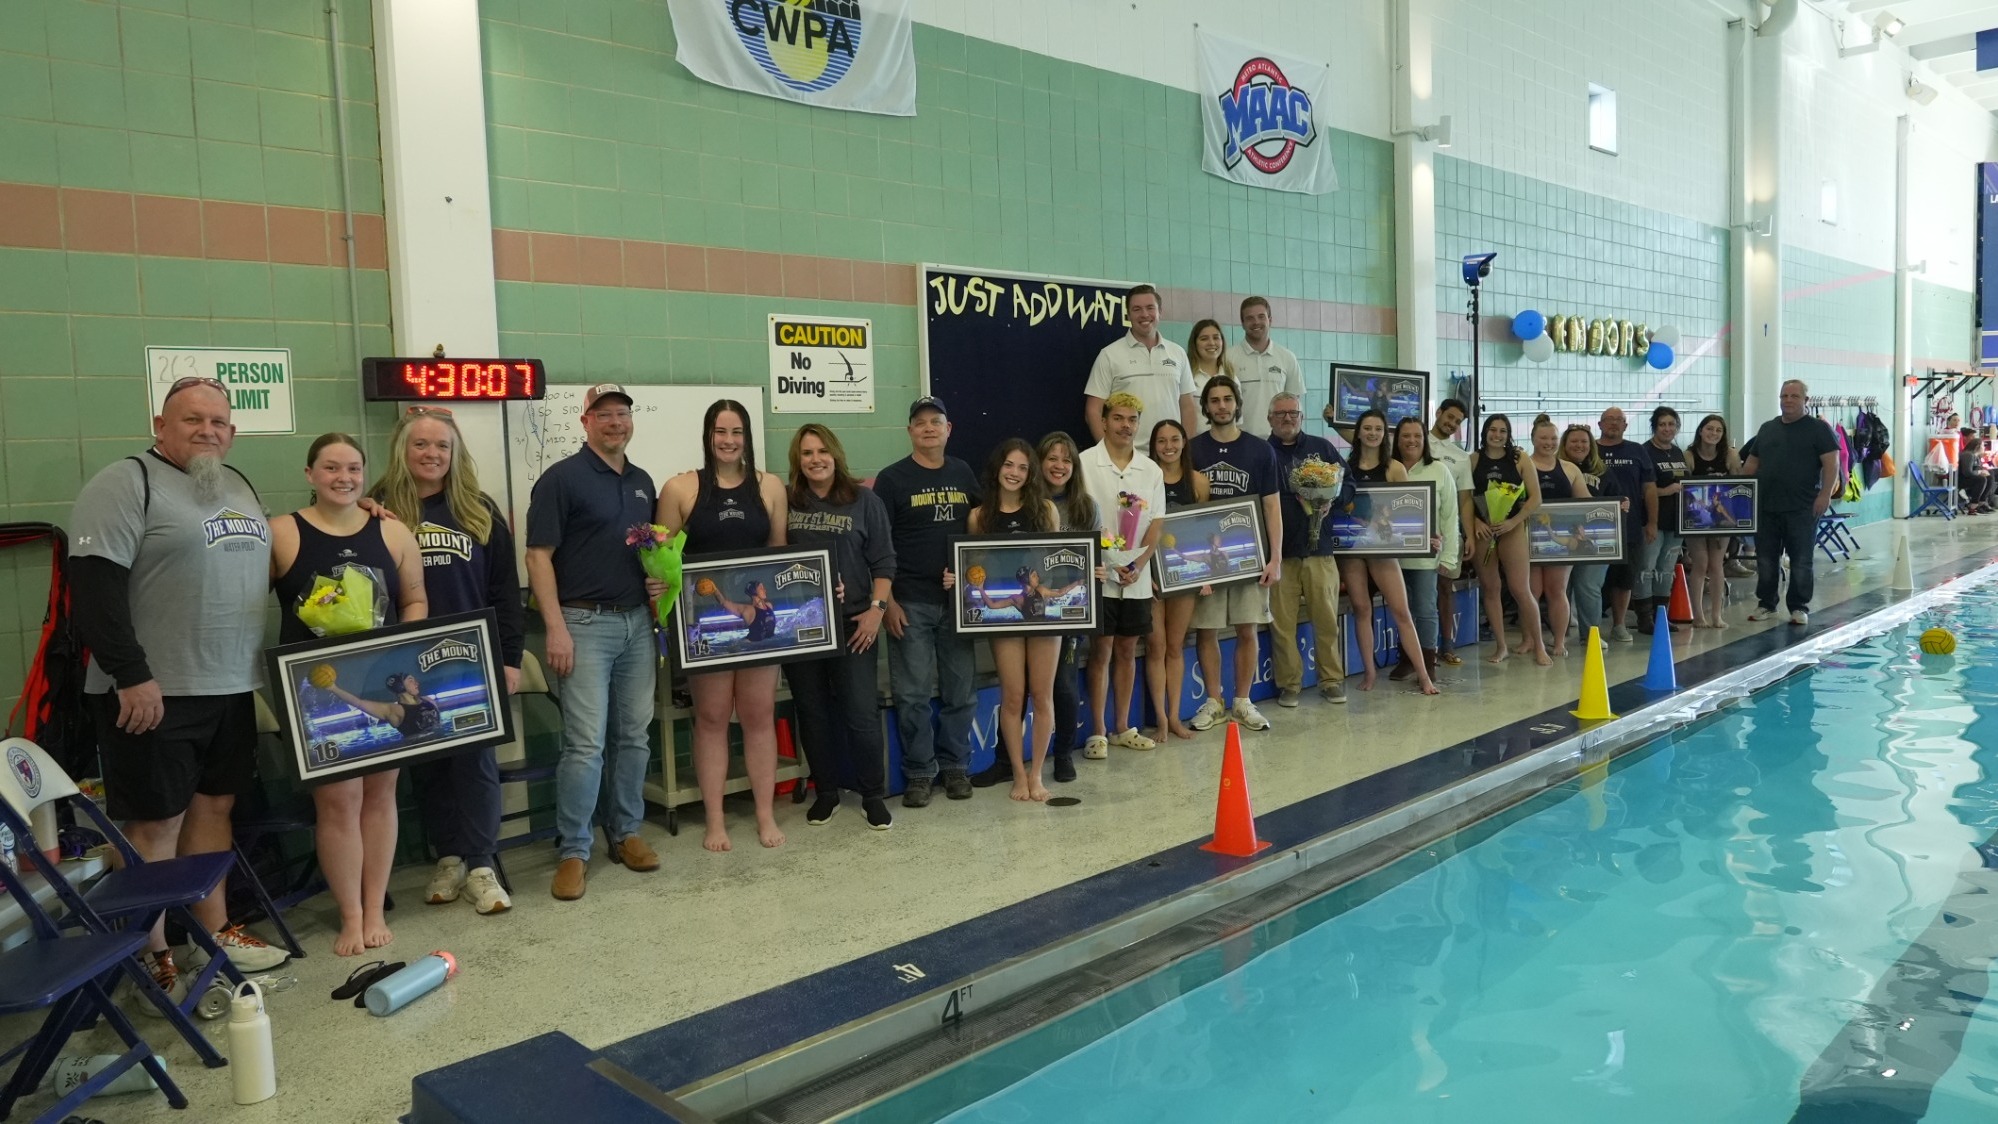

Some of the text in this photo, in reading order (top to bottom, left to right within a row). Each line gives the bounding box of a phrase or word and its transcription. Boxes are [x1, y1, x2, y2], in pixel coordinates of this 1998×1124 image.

[731, 0, 855, 58] CWPA
[1241, 62, 1283, 84] METRO ATLANTIC
[1220, 83, 1314, 166] MAAC
[1247, 149, 1268, 169] ATHLETIC
[929, 275, 1005, 316] JUST
[1012, 282, 1062, 327] ADD
[780, 324, 863, 347] CAUTION
[791, 352, 811, 370] No
[216, 362, 284, 383] PERSON
[405, 364, 532, 397] 4:30:07
[778, 376, 825, 398] Diving
[228, 389, 270, 409] LIMIT
[1216, 470, 1248, 488] MOUNT
[911, 492, 937, 507] MOUNT
[933, 504, 956, 522] M
[206, 519, 265, 543] THE MOUNT
[223, 541, 256, 552] WATER POLO
[418, 532, 469, 555] MOUNT
[433, 554, 451, 566] POLO
[1046, 554, 1084, 568] THE MOUNT
[777, 570, 820, 585] THE MOUNT
[967, 608, 983, 622] 12
[420, 644, 477, 670] THE MOUNT
[693, 639, 711, 655] 14
[313, 740, 339, 763] 16
[942, 984, 973, 1025] 4 FT
